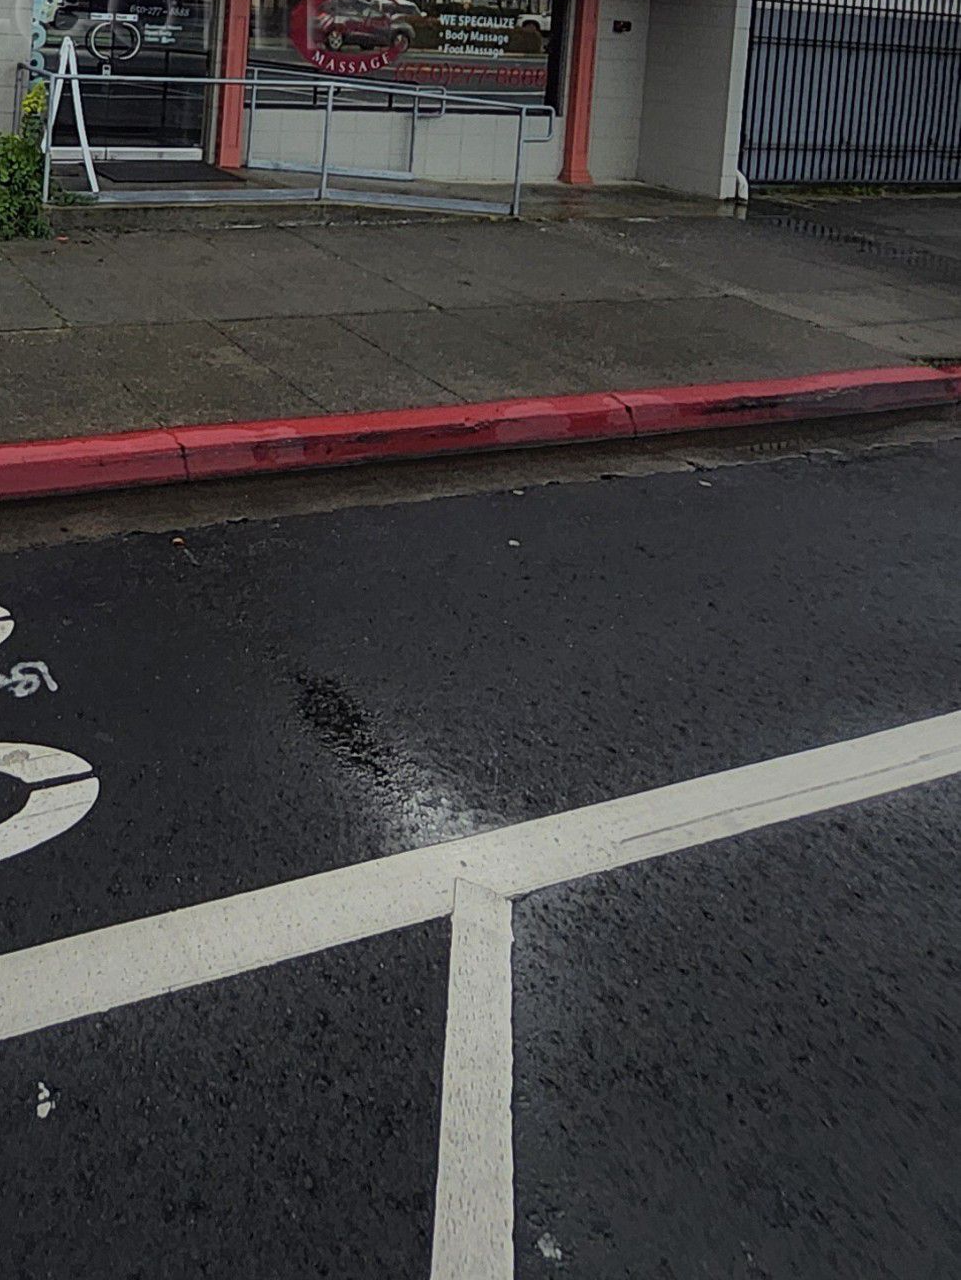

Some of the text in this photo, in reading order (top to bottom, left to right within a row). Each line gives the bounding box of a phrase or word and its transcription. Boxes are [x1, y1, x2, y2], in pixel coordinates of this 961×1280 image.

[439, 14, 515, 29] WE SPECIALIZE
[445, 29, 509, 45] Body Massage
[443, 44, 505, 59] Foot Massage
[312, 50, 391, 74] MASSAGE
